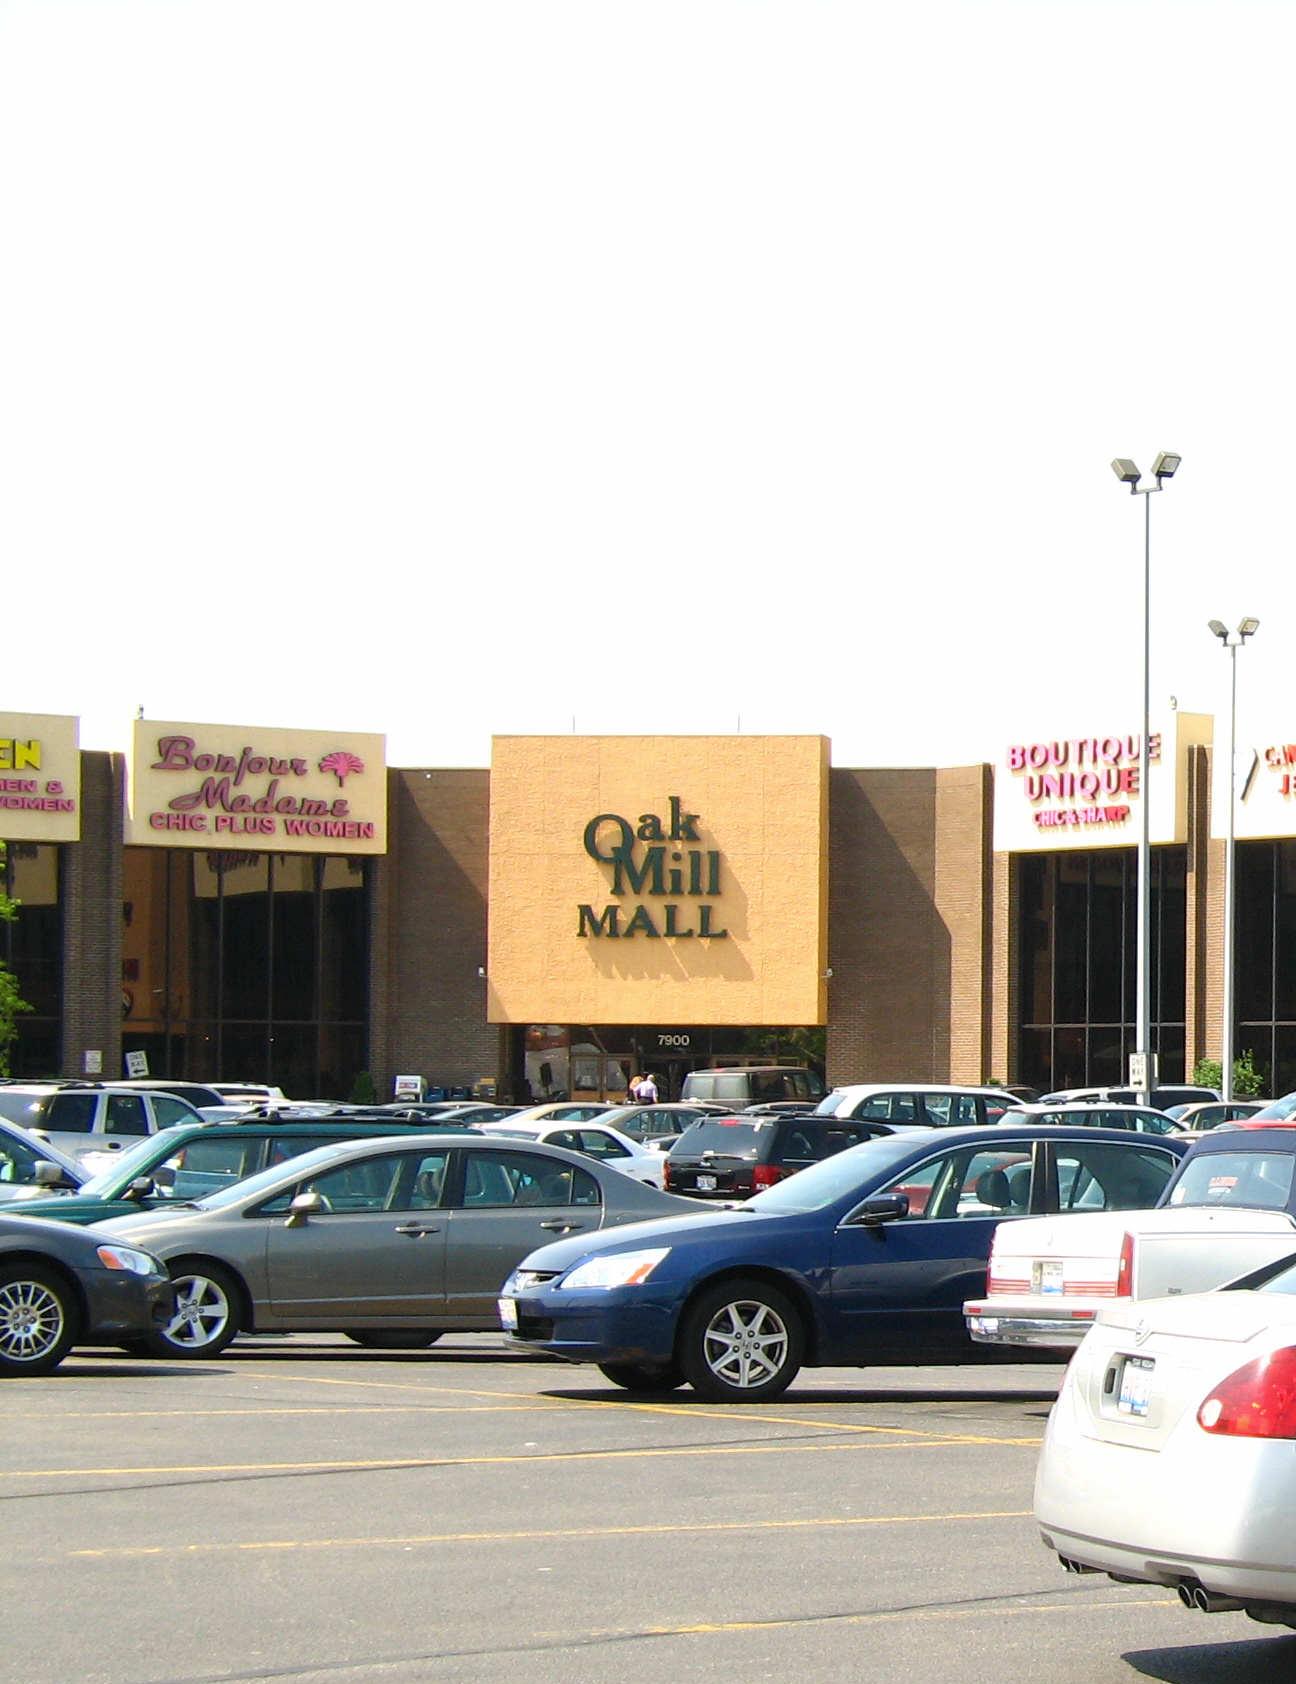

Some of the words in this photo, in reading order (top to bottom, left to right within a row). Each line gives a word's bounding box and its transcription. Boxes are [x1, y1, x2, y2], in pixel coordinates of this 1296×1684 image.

[152, 735, 309, 786] Bonjour
[1007, 733, 1161, 769] BOUTIQUE
[0, 779, 38, 793] EN
[46, 780, 64, 793] &
[169, 776, 350, 817] Madame
[1024, 767, 1140, 800] UNIQUE
[150, 812, 207, 832] CHIC
[215, 815, 277, 835] PLUS
[284, 819, 375, 839] WOMEN
[584, 796, 701, 863] Oak
[610, 846, 722, 896] Mill
[576, 904, 728, 938] MALL
[657, 1034, 690, 1046] 7900
